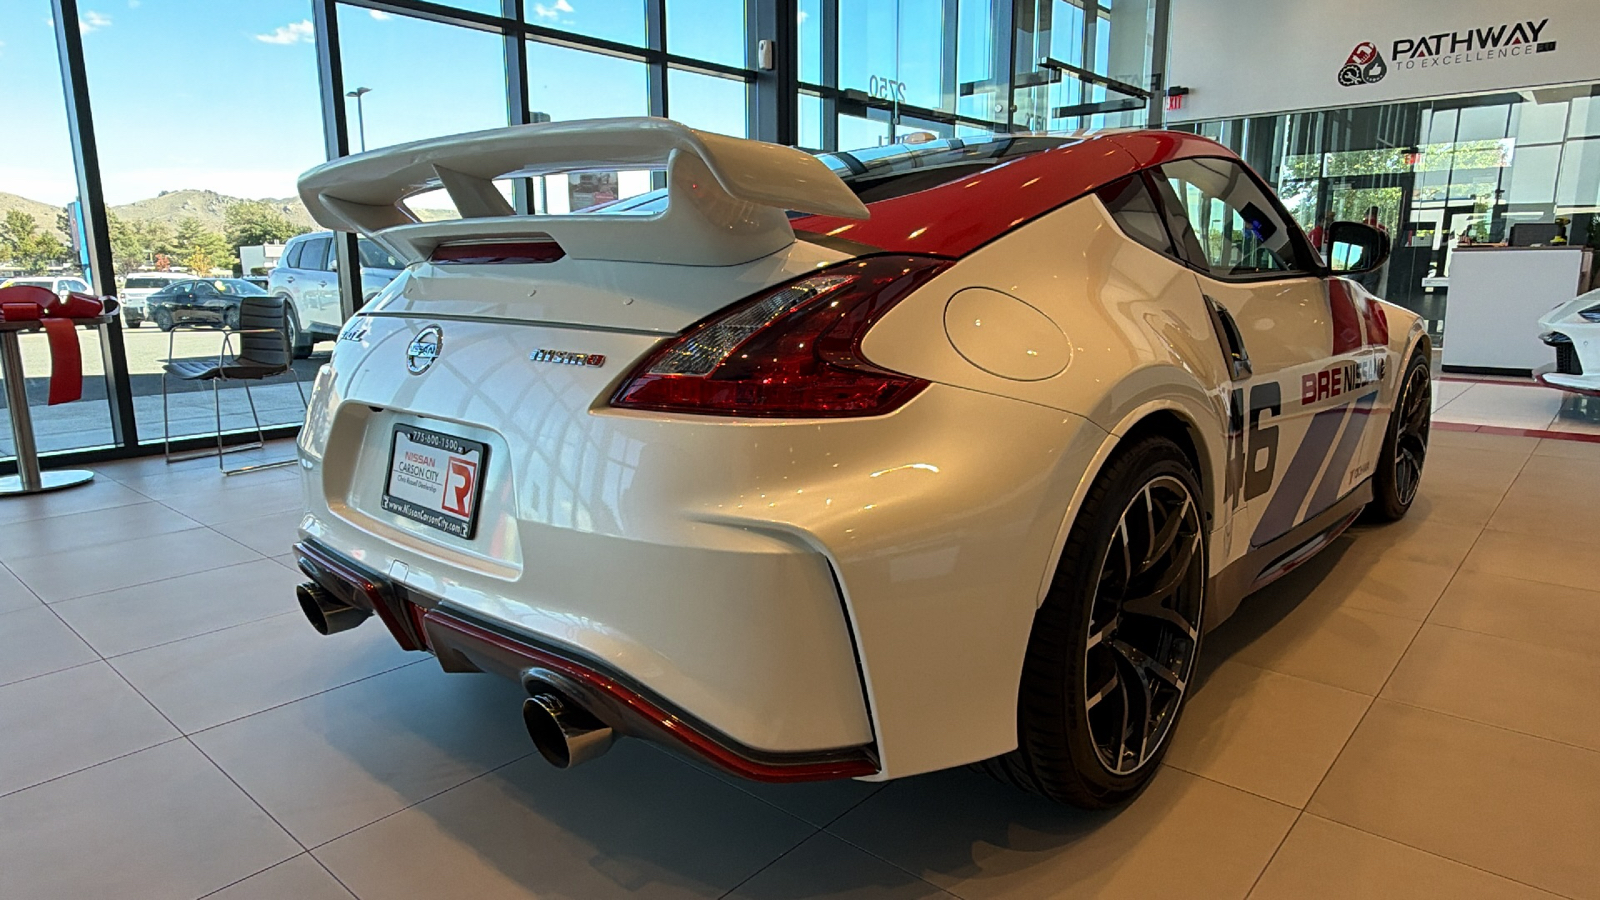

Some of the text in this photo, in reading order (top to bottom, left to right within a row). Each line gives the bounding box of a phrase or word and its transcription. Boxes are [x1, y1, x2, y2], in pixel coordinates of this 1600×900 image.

[1392, 18, 1549, 61] PATHWAY
[1396, 61, 1415, 71] TO
[1421, 44, 1533, 68] EXCELLENCE
[1301, 367, 1342, 405] BRE
[412, 431, 458, 449] 775-600-1500
[1224, 382, 1280, 510] 46
[399, 461, 439, 482] CARSON CITY
[405, 452, 435, 467] NISSAN
[418, 480, 437, 493] Dealership
[389, 502, 460, 533] www.NissanCarsonCity.com
